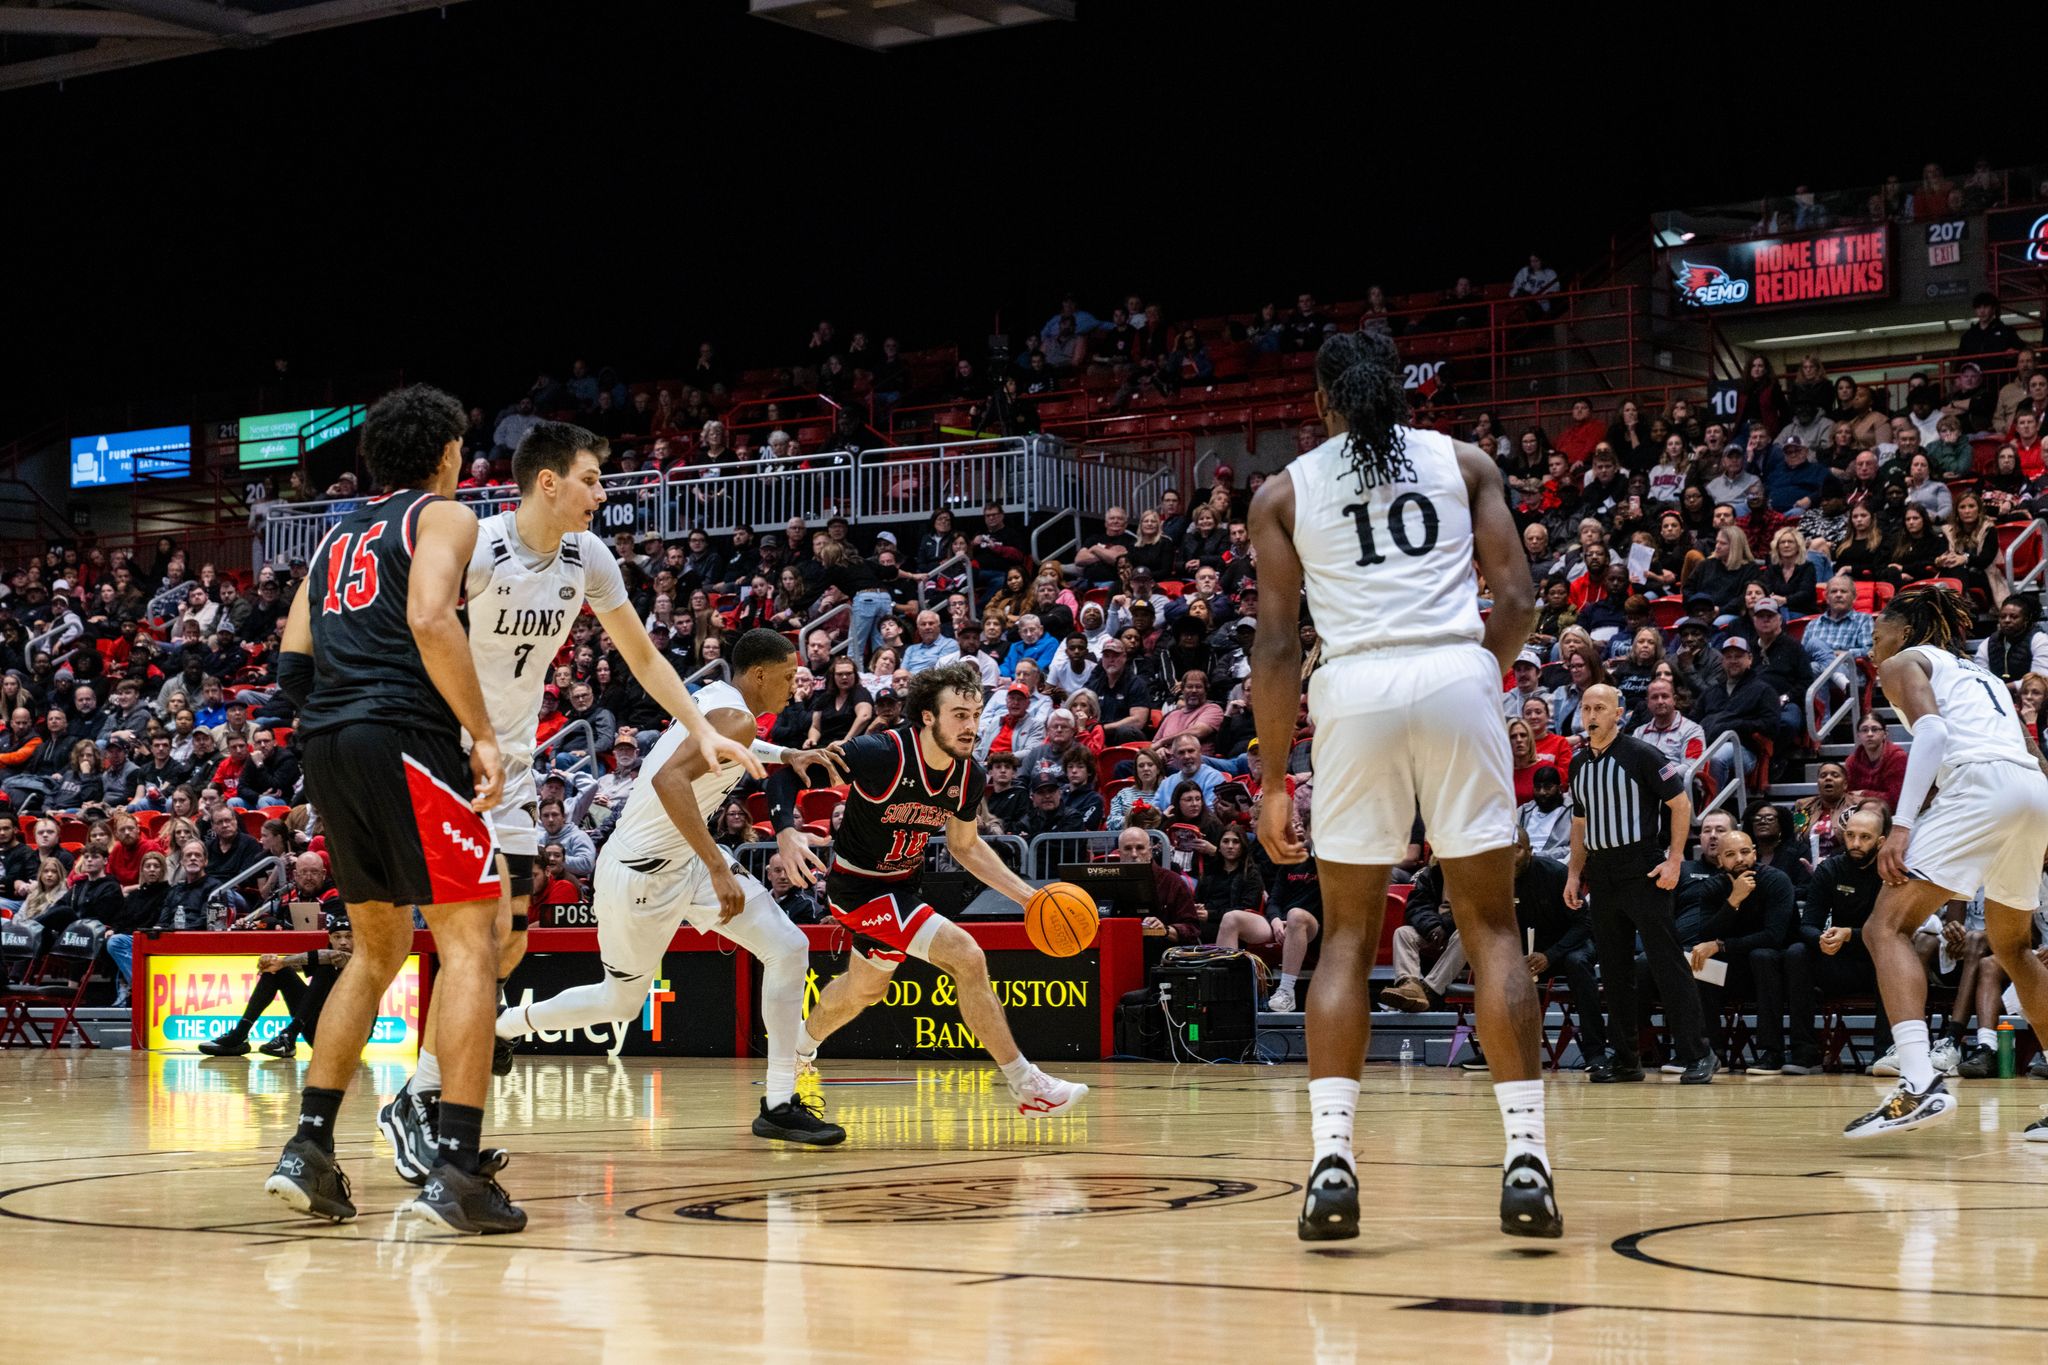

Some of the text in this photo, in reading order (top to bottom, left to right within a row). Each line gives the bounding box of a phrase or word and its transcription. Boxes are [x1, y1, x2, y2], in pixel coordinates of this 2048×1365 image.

[1929, 221, 1965, 242] 207
[1755, 232, 1883, 274] HOME OF THE
[1934, 244, 1955, 265] EXIT
[1695, 282, 1746, 303] SEMO
[1755, 261, 1884, 305] REDHAWKS
[1711, 389, 1738, 415] 10
[120, 461, 132, 471] FRI
[602, 503, 634, 527] 108
[1342, 492, 1440, 567] 10
[322, 520, 389, 616] 15
[493, 609, 566, 637] LIONS
[514, 643, 536, 679] 7
[1975, 677, 2007, 717] 1
[441, 820, 485, 859] SEMO
[554, 905, 598, 925] POSS
[153, 973, 233, 1028] PLAZA
[931, 974, 958, 1006] &
[989, 979, 1089, 1008] USTON
[175, 1019, 207, 1038] THE
[209, 1019, 260, 1039] QUIK
[913, 1016, 986, 1049] BAN
